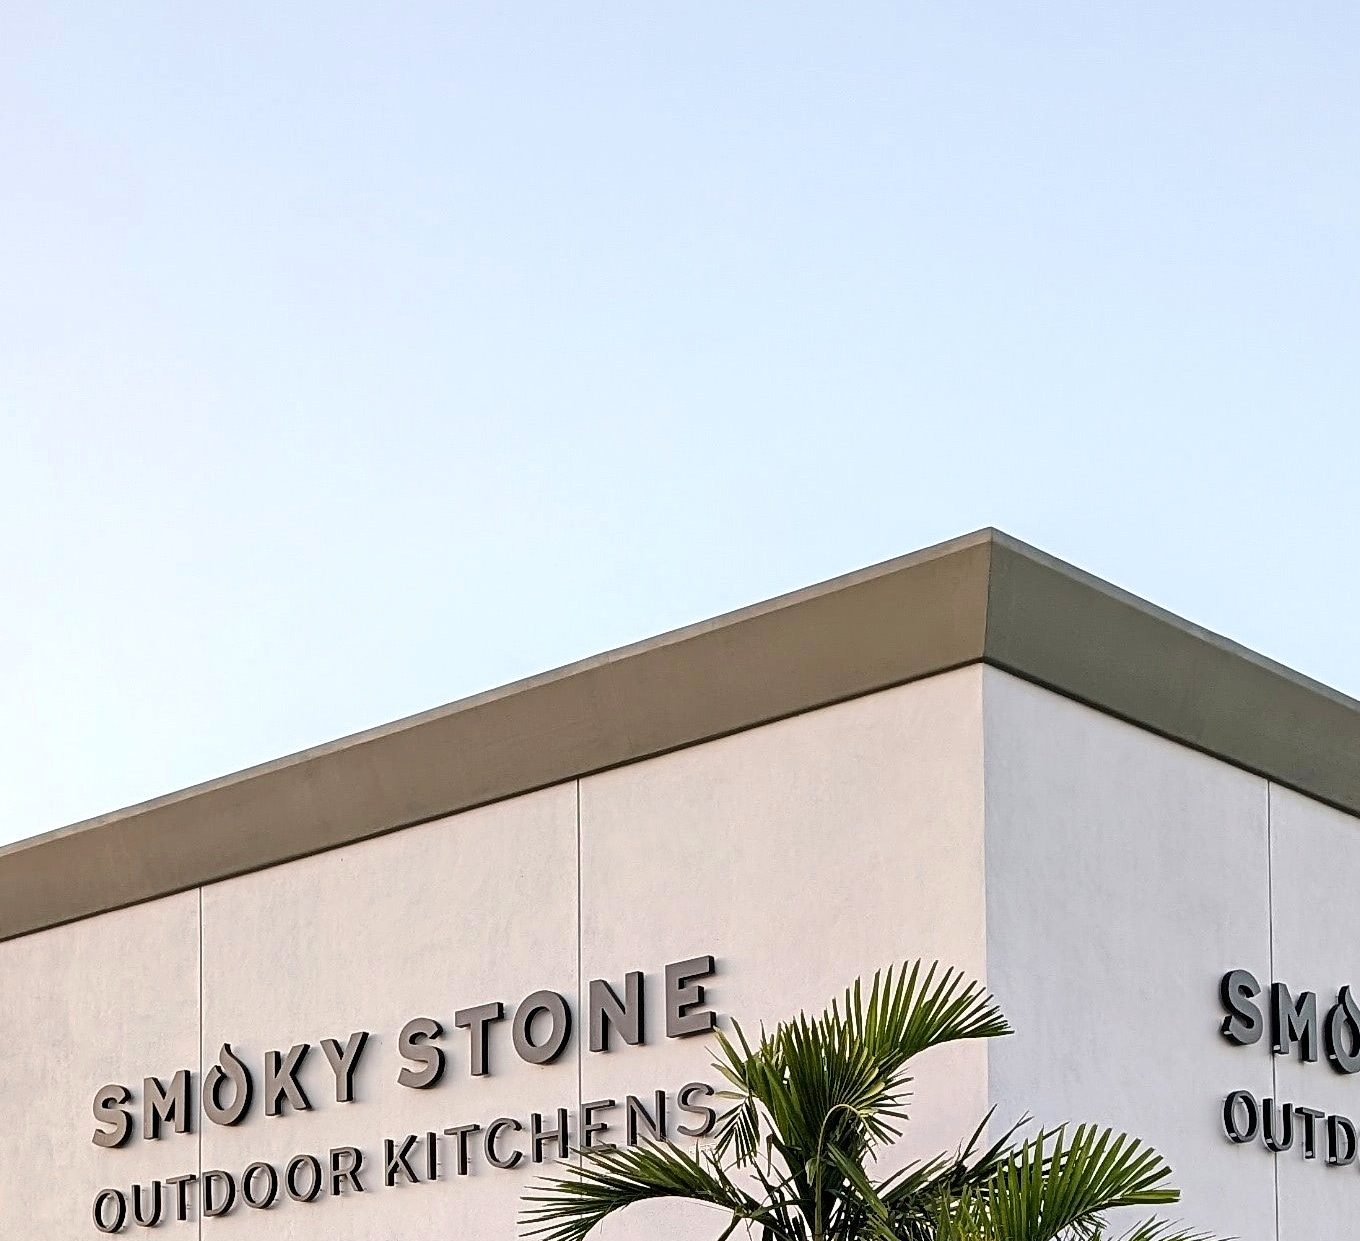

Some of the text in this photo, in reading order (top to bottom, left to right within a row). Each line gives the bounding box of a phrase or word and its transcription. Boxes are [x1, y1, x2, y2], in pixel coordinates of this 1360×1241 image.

[91, 955, 717, 1149] SMOKY STONE
[94, 1082, 717, 1233] OUTDOOR KITCHENS
